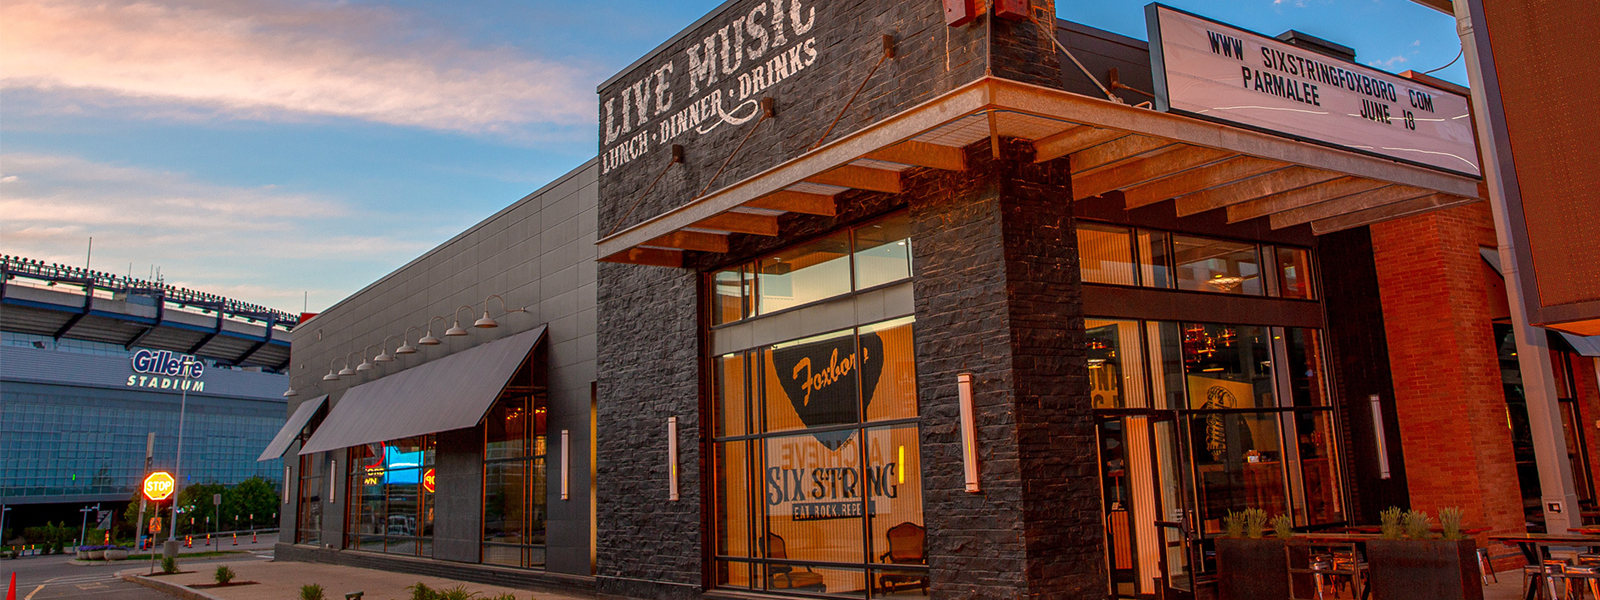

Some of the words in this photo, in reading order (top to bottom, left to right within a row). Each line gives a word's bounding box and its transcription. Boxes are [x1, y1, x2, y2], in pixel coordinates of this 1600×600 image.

[604, 60, 673, 146] LIVE
[687, 0, 816, 98] MUSIC
[1207, 29, 1244, 61] WWW
[1261, 46, 1397, 103] SIXSTRINGFOXBORO
[1408, 88, 1434, 114] COM
[1241, 65, 1321, 107] PARMALEE
[602, 130, 649, 175] LUNCH
[659, 88, 759, 145] DINNER
[738, 37, 818, 101] DRINKS
[1359, 98, 1391, 125] JUNE
[1402, 109, 1416, 131] 18
[126, 375, 205, 392] STADIUM
[132, 349, 204, 379] Gillette
[146, 481, 172, 491] STOP
[767, 466, 806, 506] SIX
[811, 462, 897, 501] STRNG
